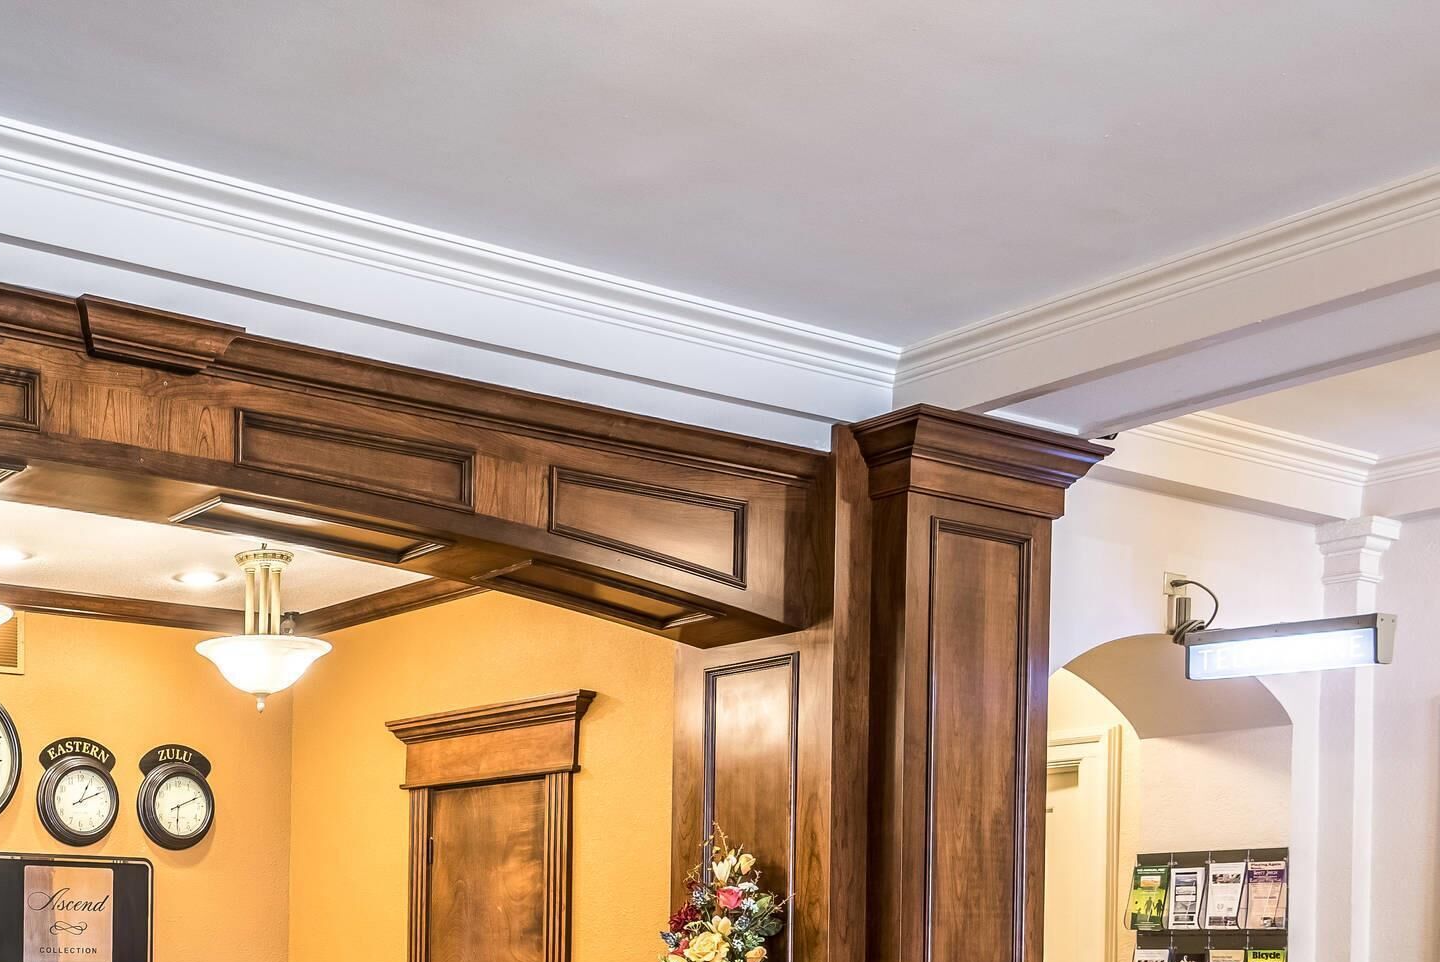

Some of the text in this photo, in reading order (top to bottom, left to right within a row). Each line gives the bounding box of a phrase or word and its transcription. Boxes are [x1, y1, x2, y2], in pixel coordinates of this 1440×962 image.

[47, 741, 109, 763] EASTERN
[157, 748, 192, 763] ZULU
[27, 887, 109, 912] Ascend
[39, 946, 97, 955] COLLECTION
[1252, 951, 1281, 960] Bicycle
